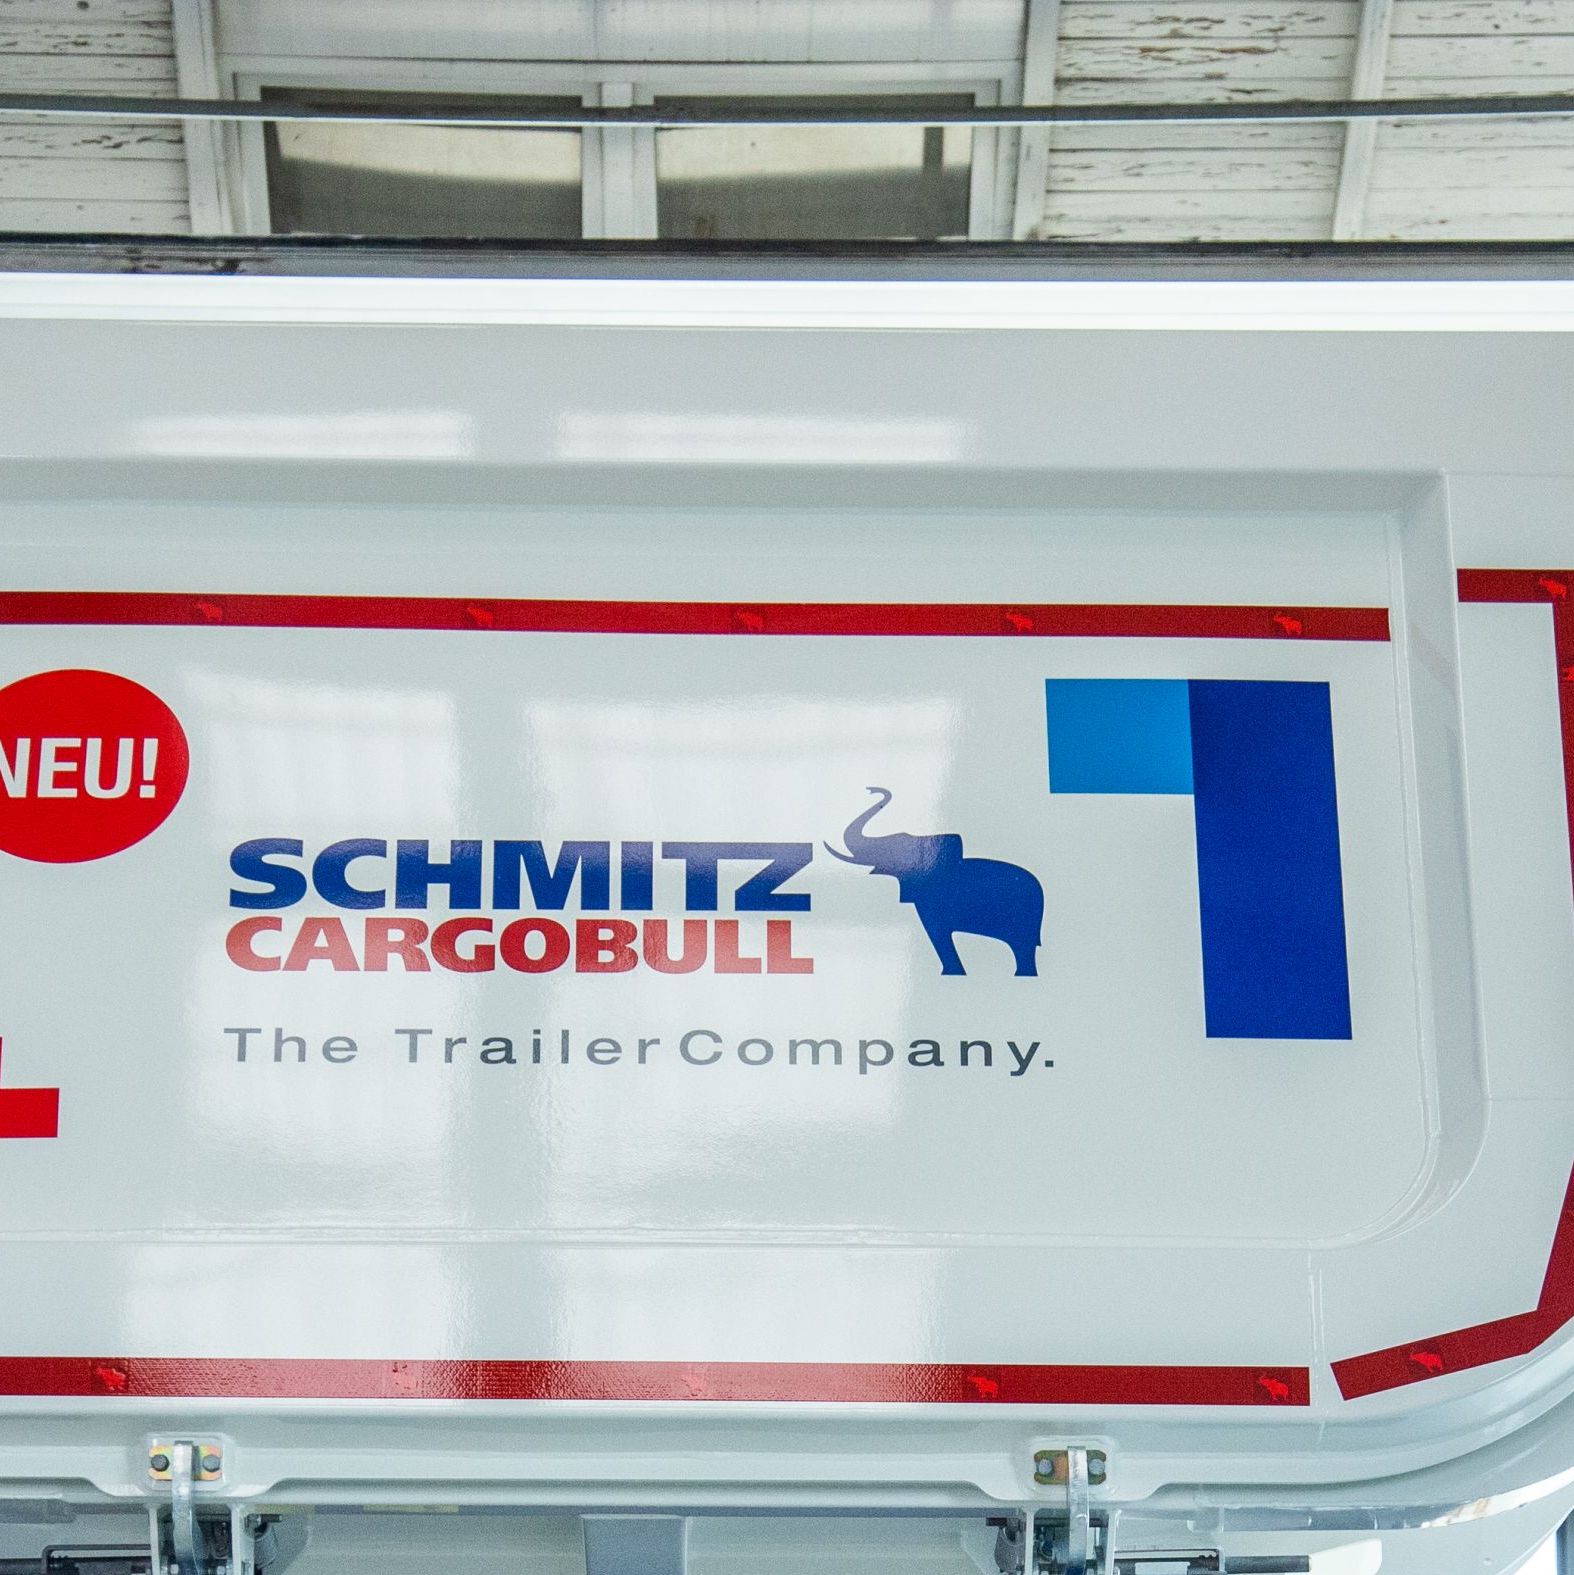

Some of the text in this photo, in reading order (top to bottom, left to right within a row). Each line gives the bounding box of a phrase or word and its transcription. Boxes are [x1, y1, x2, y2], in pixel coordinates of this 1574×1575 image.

[228, 837, 813, 913] SCHMITZ
[224, 916, 815, 975] CARGOBULL
[223, 1027, 358, 1064] The
